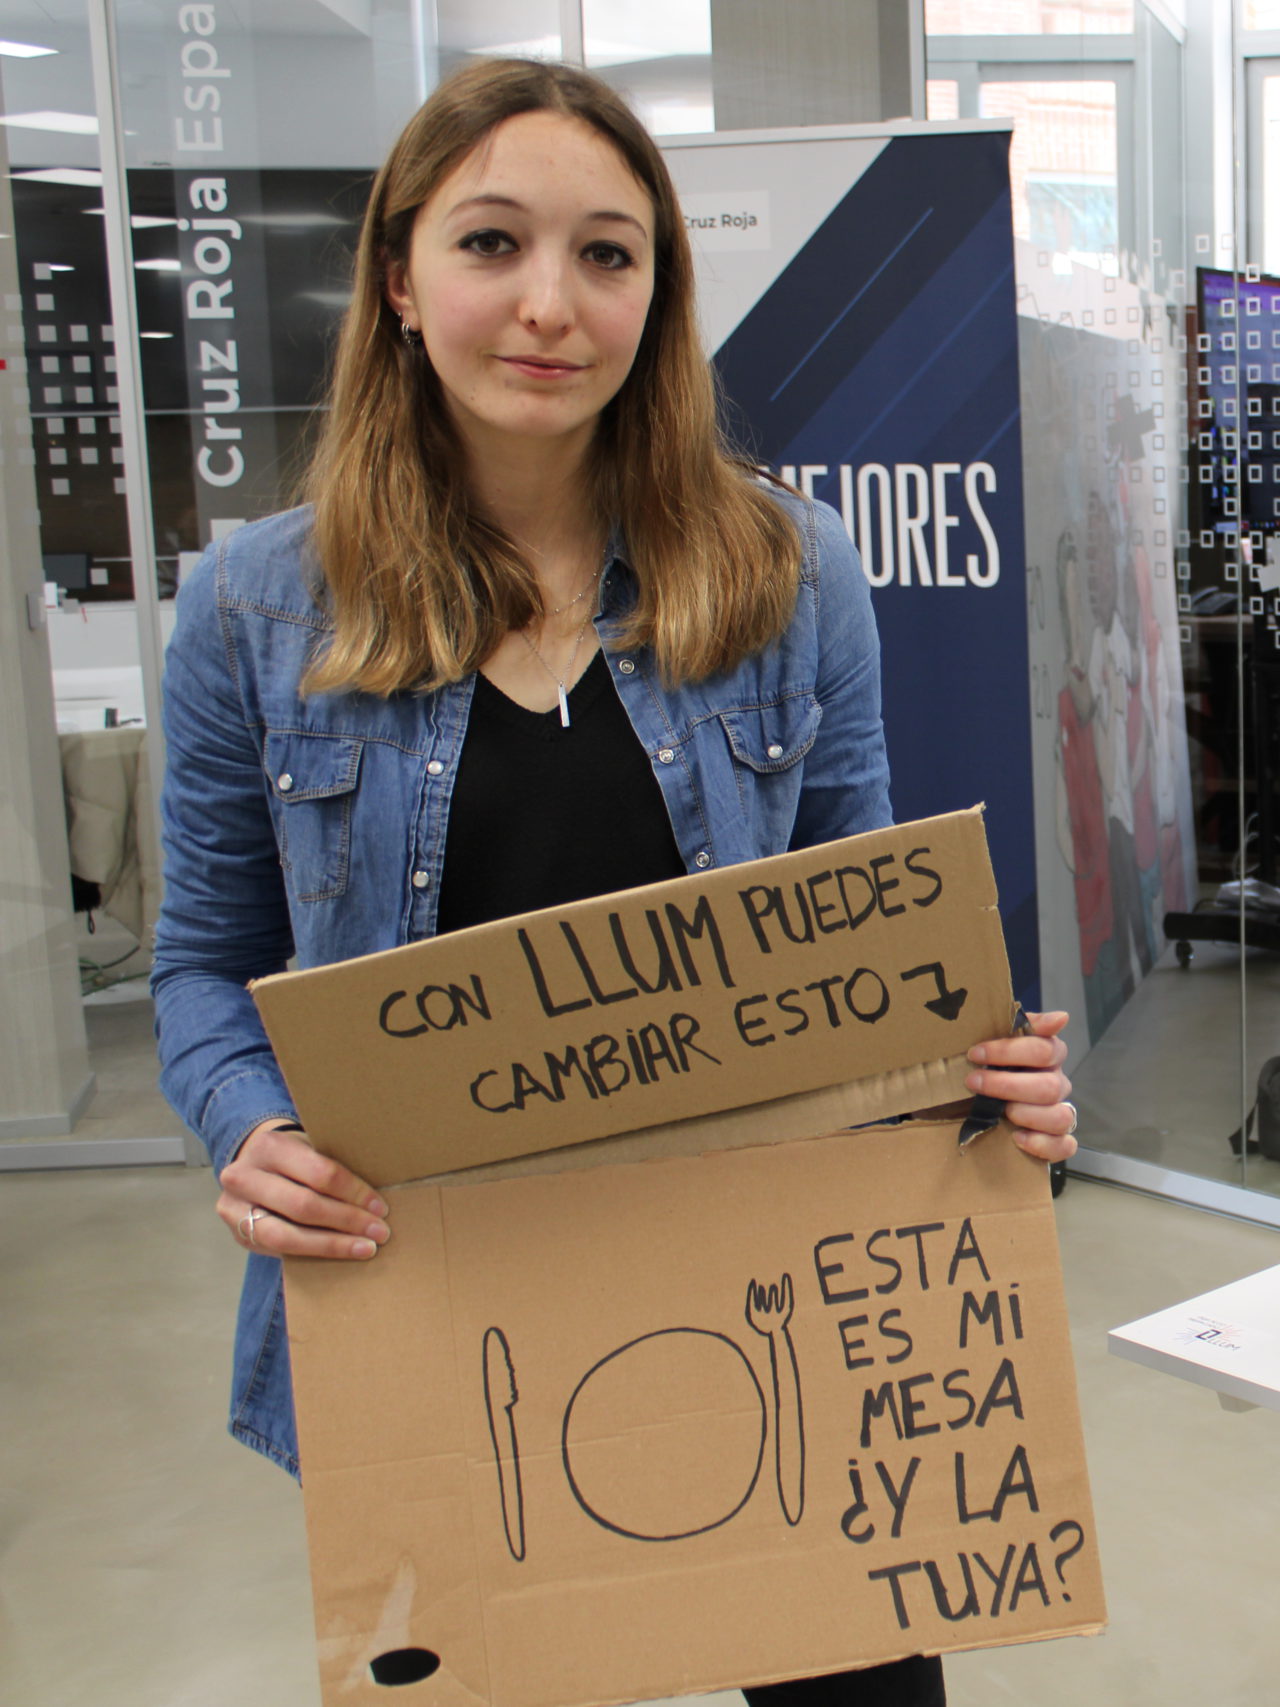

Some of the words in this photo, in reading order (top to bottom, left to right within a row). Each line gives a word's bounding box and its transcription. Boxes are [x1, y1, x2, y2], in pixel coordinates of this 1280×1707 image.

[175, 4, 231, 151] Espa
[178, 177, 242, 319] Roja
[721, 211, 757, 230] Roja
[198, 340, 244, 488] Cruz
[379, 974, 492, 1038] CON
[517, 894, 736, 1018] LLUM
[738, 847, 943, 954] PUEDES
[733, 967, 891, 1047] ESTO
[814, 1216, 991, 1305] ESTA
[838, 1308, 913, 1370] ES
[860, 1357, 1025, 1448] MESA
[841, 1457, 922, 1544] ¿Y
[955, 1443, 1040, 1525] LA
[868, 1519, 1085, 1630] TUYA?
